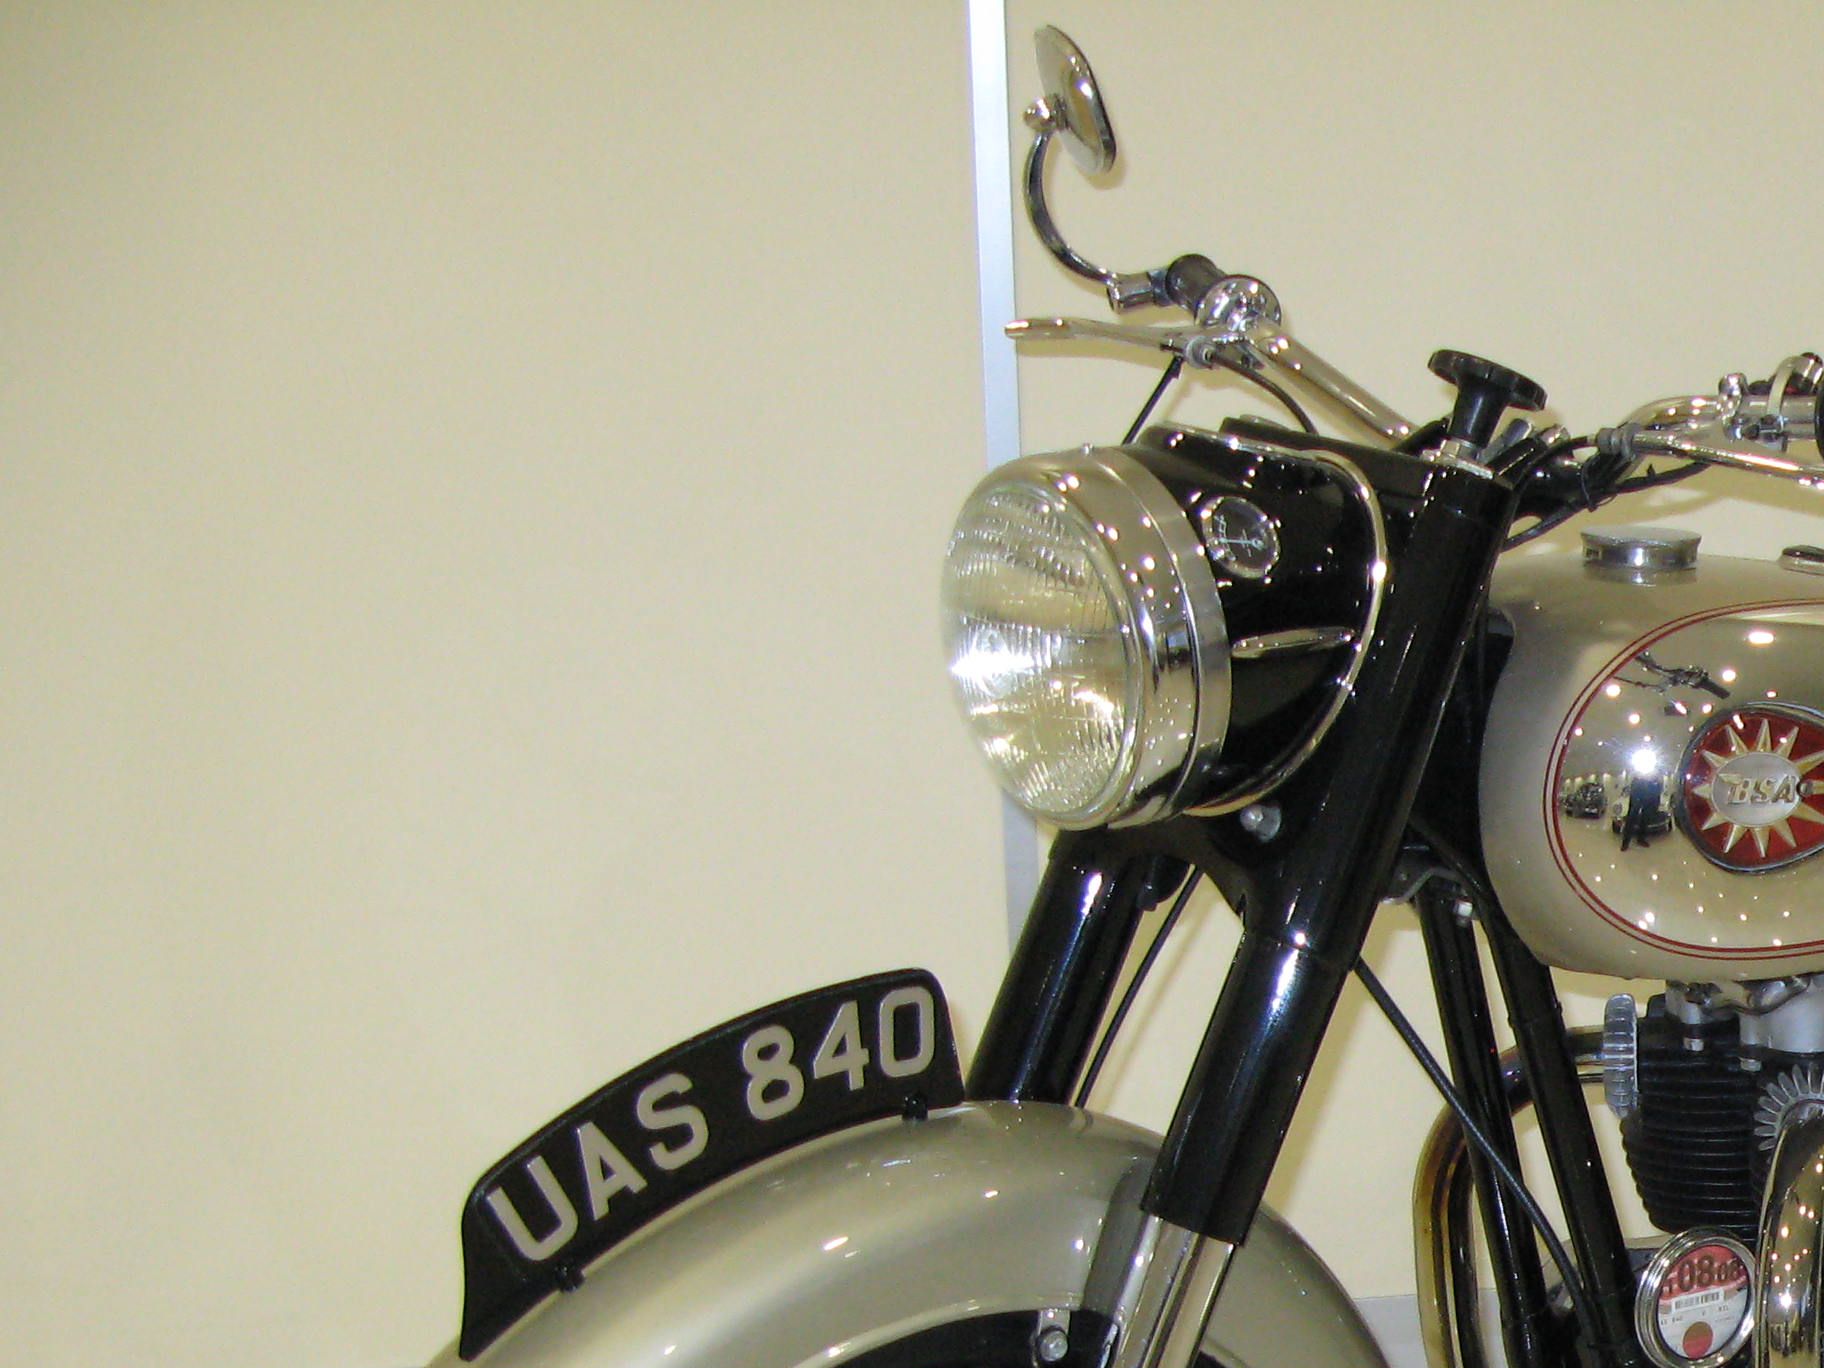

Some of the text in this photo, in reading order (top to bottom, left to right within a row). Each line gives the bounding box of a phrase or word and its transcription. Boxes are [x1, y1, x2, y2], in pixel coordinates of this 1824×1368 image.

[1718, 773, 1796, 805] BSA
[484, 985, 936, 1262] UAS 840
